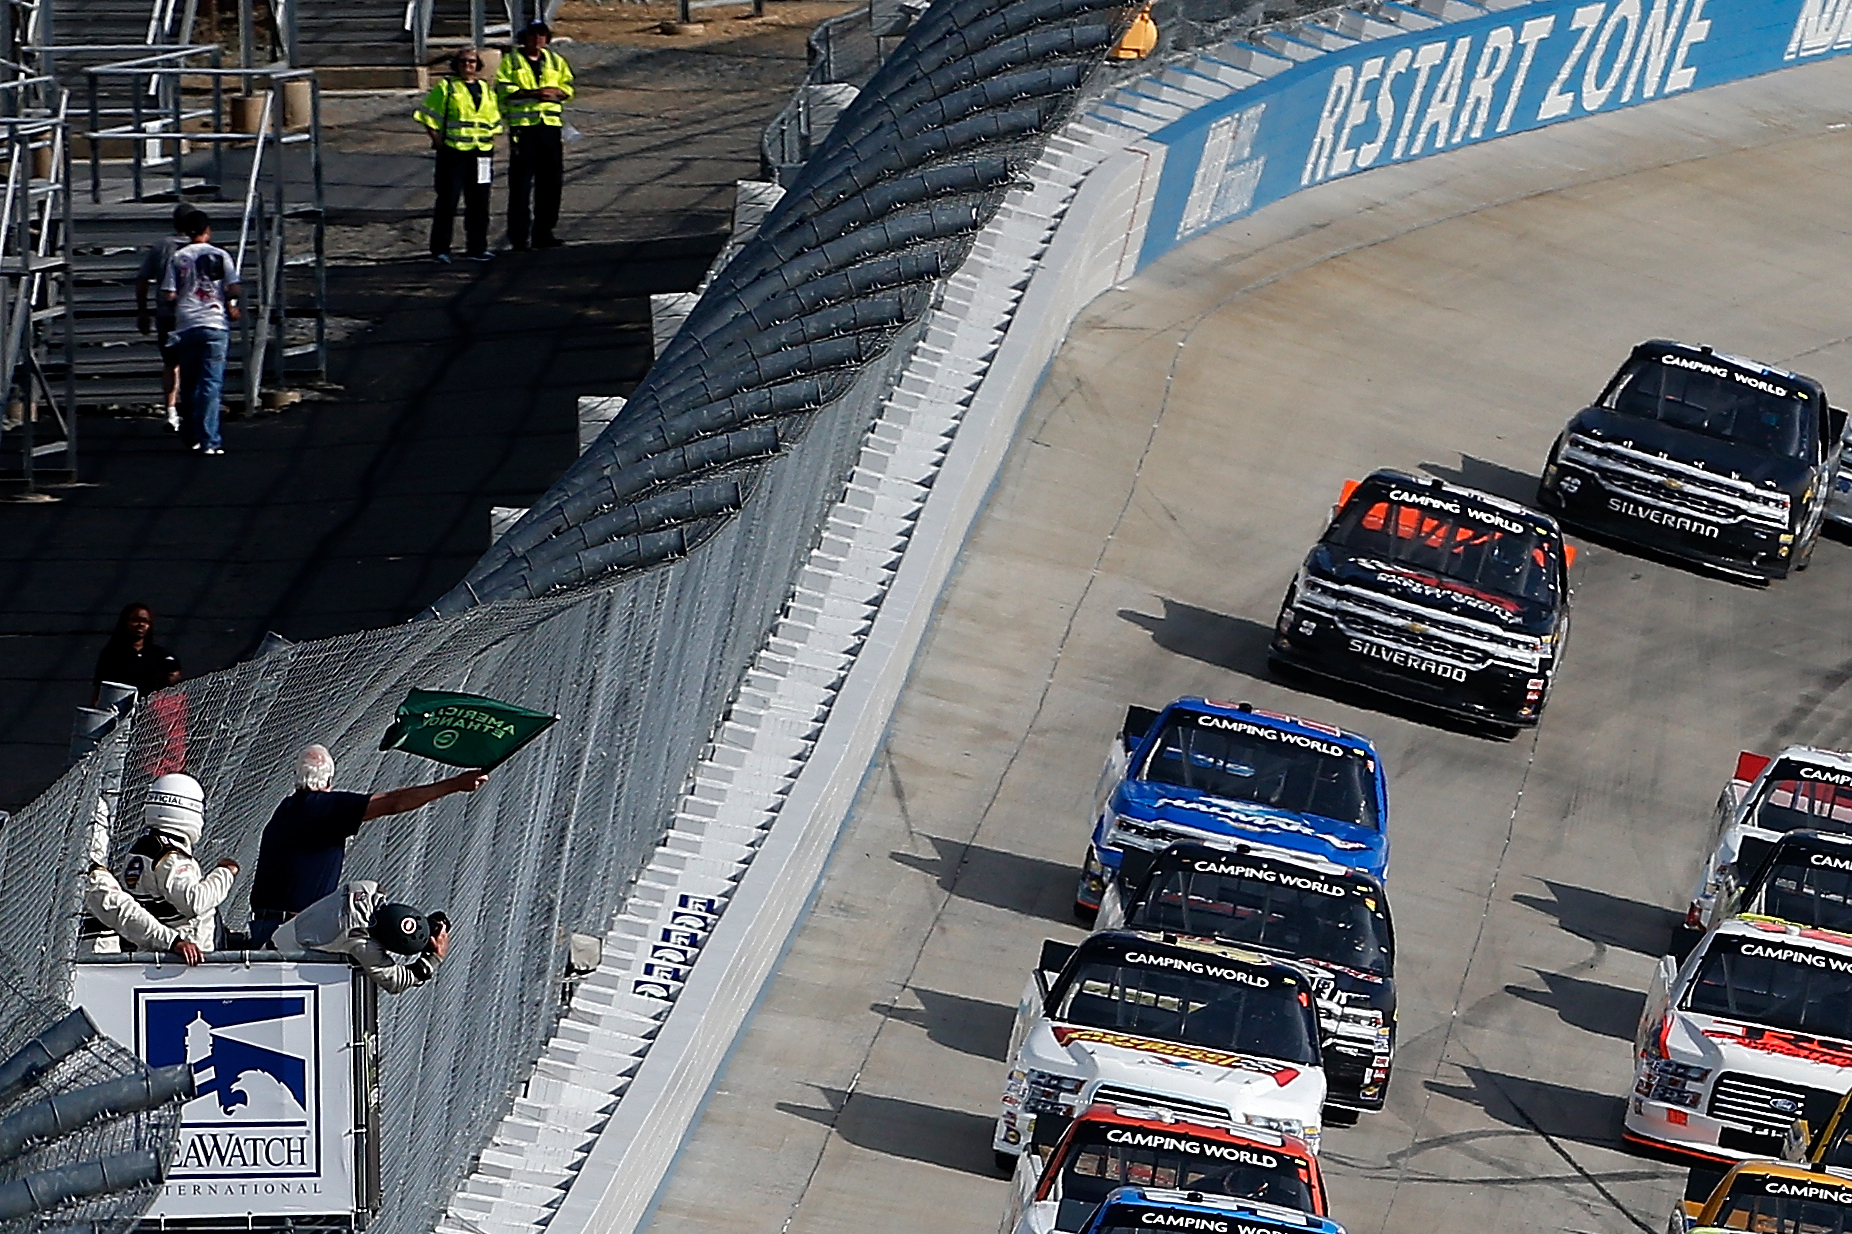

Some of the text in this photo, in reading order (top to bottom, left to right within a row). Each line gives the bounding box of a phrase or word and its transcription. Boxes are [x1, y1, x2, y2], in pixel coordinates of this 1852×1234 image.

[1301, 22, 1555, 186] RESTART
[1536, 0, 1711, 120] ZONE
[1661, 355, 1787, 397] CAMPING WORLD
[1389, 489, 1524, 534] CAMPING WORLD
[1347, 638, 1468, 683] SILVERADO
[1198, 715, 1344, 757] CAMPING WORLD
[1194, 861, 1345, 897] CAMPING WORLD
[1125, 951, 1269, 989] CAMPING WORLD
[1740, 943, 1826, 968] CAMPING
[170, 1133, 307, 1168] EAWATCH
[1106, 1130, 1277, 1169] CAMPING WORLD
[164, 1182, 322, 1196] TERNATIONAL
[1765, 1182, 1852, 1204] CAMPING
[1141, 1212, 1228, 1234] CAMPING
